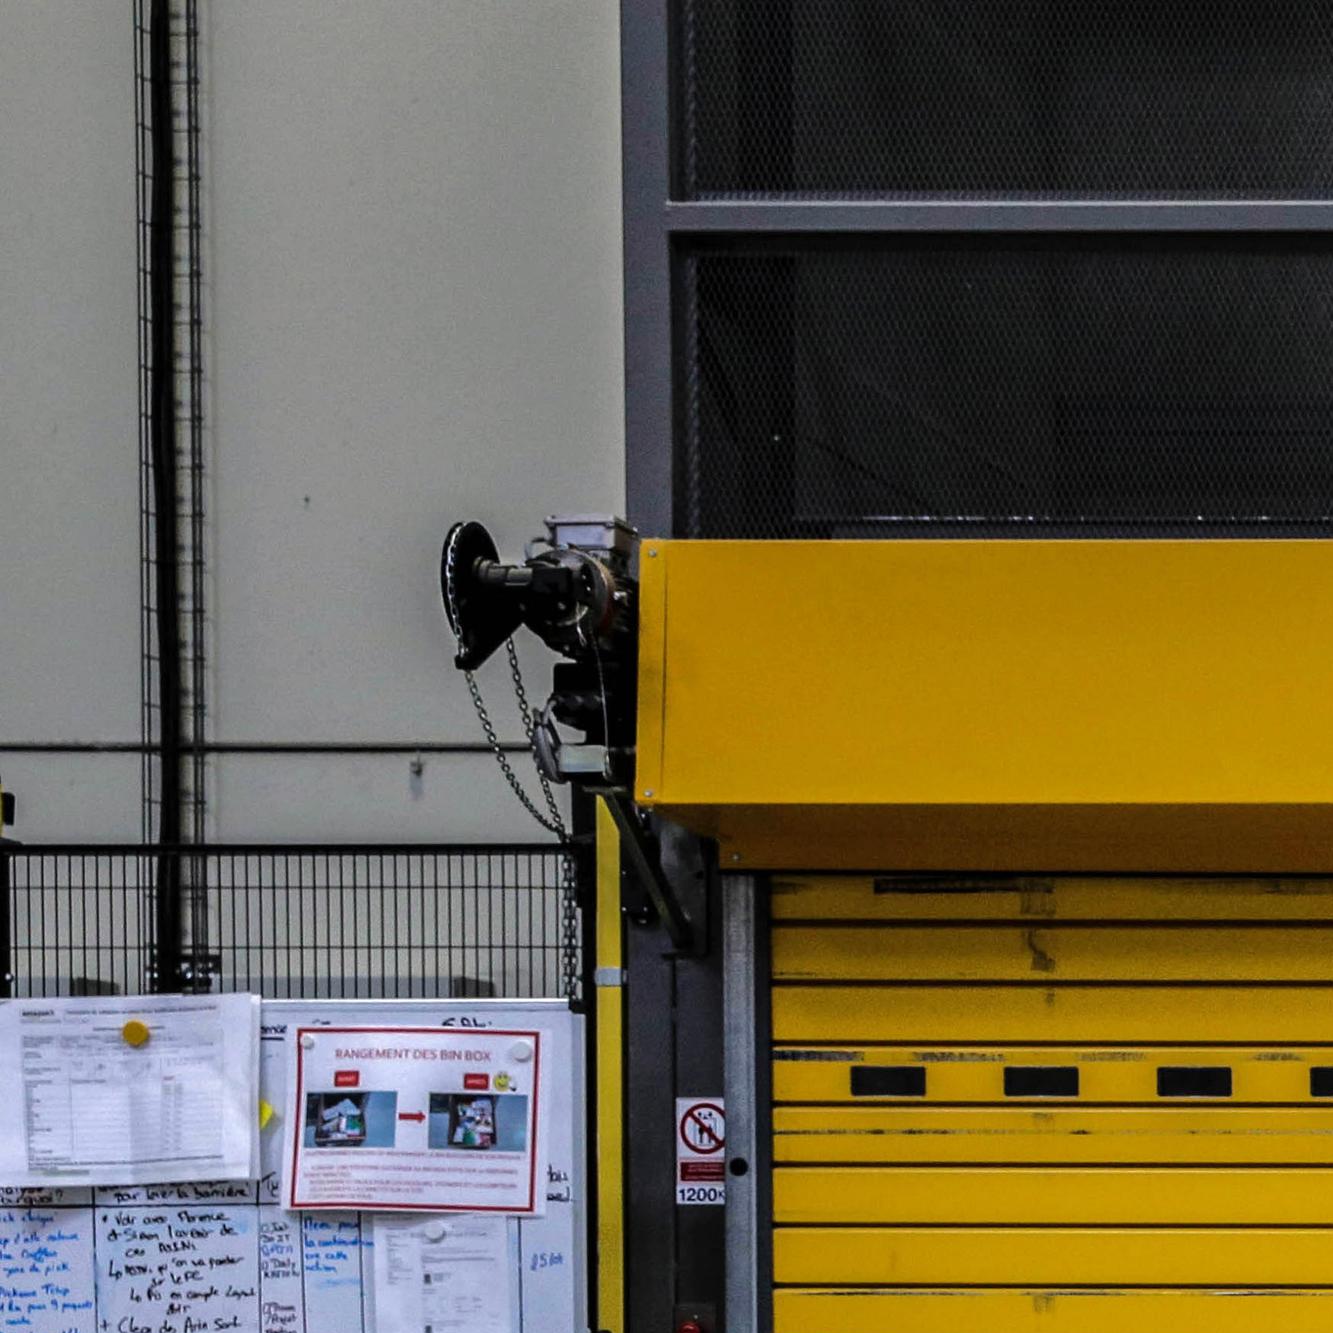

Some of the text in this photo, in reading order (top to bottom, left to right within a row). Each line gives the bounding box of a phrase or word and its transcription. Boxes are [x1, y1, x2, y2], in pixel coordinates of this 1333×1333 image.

[334, 1048, 492, 1062] RANGEMENT DES BIN BOX
